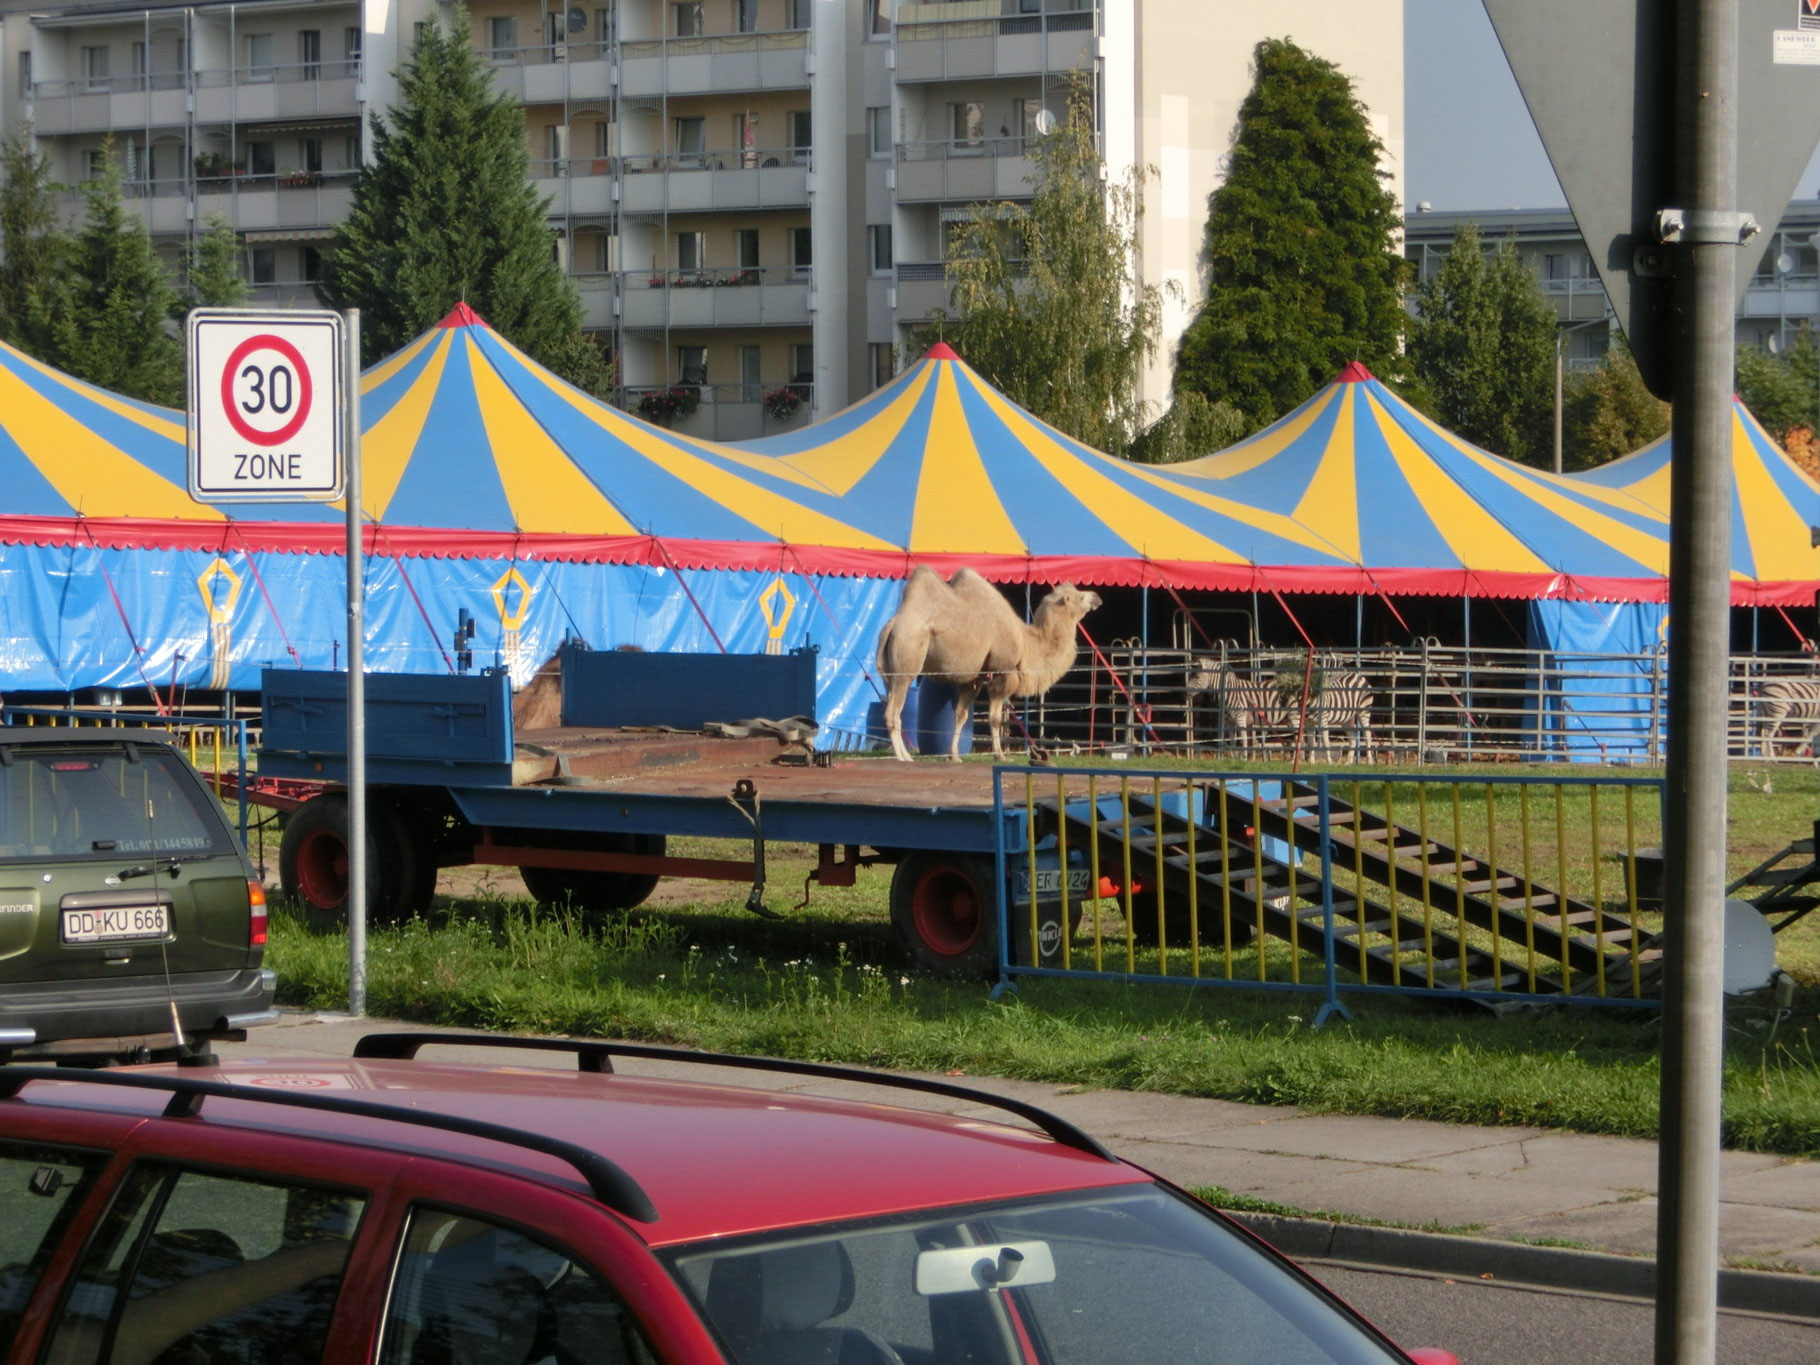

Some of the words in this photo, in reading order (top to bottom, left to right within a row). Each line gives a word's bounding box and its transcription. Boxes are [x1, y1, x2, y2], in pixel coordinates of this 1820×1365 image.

[242, 365, 292, 414] 30
[234, 454, 302, 480] ZONE
[117, 839, 138, 851] Tel.
[0, 904, 33, 913] FINDER
[134, 909, 164, 930] 666
